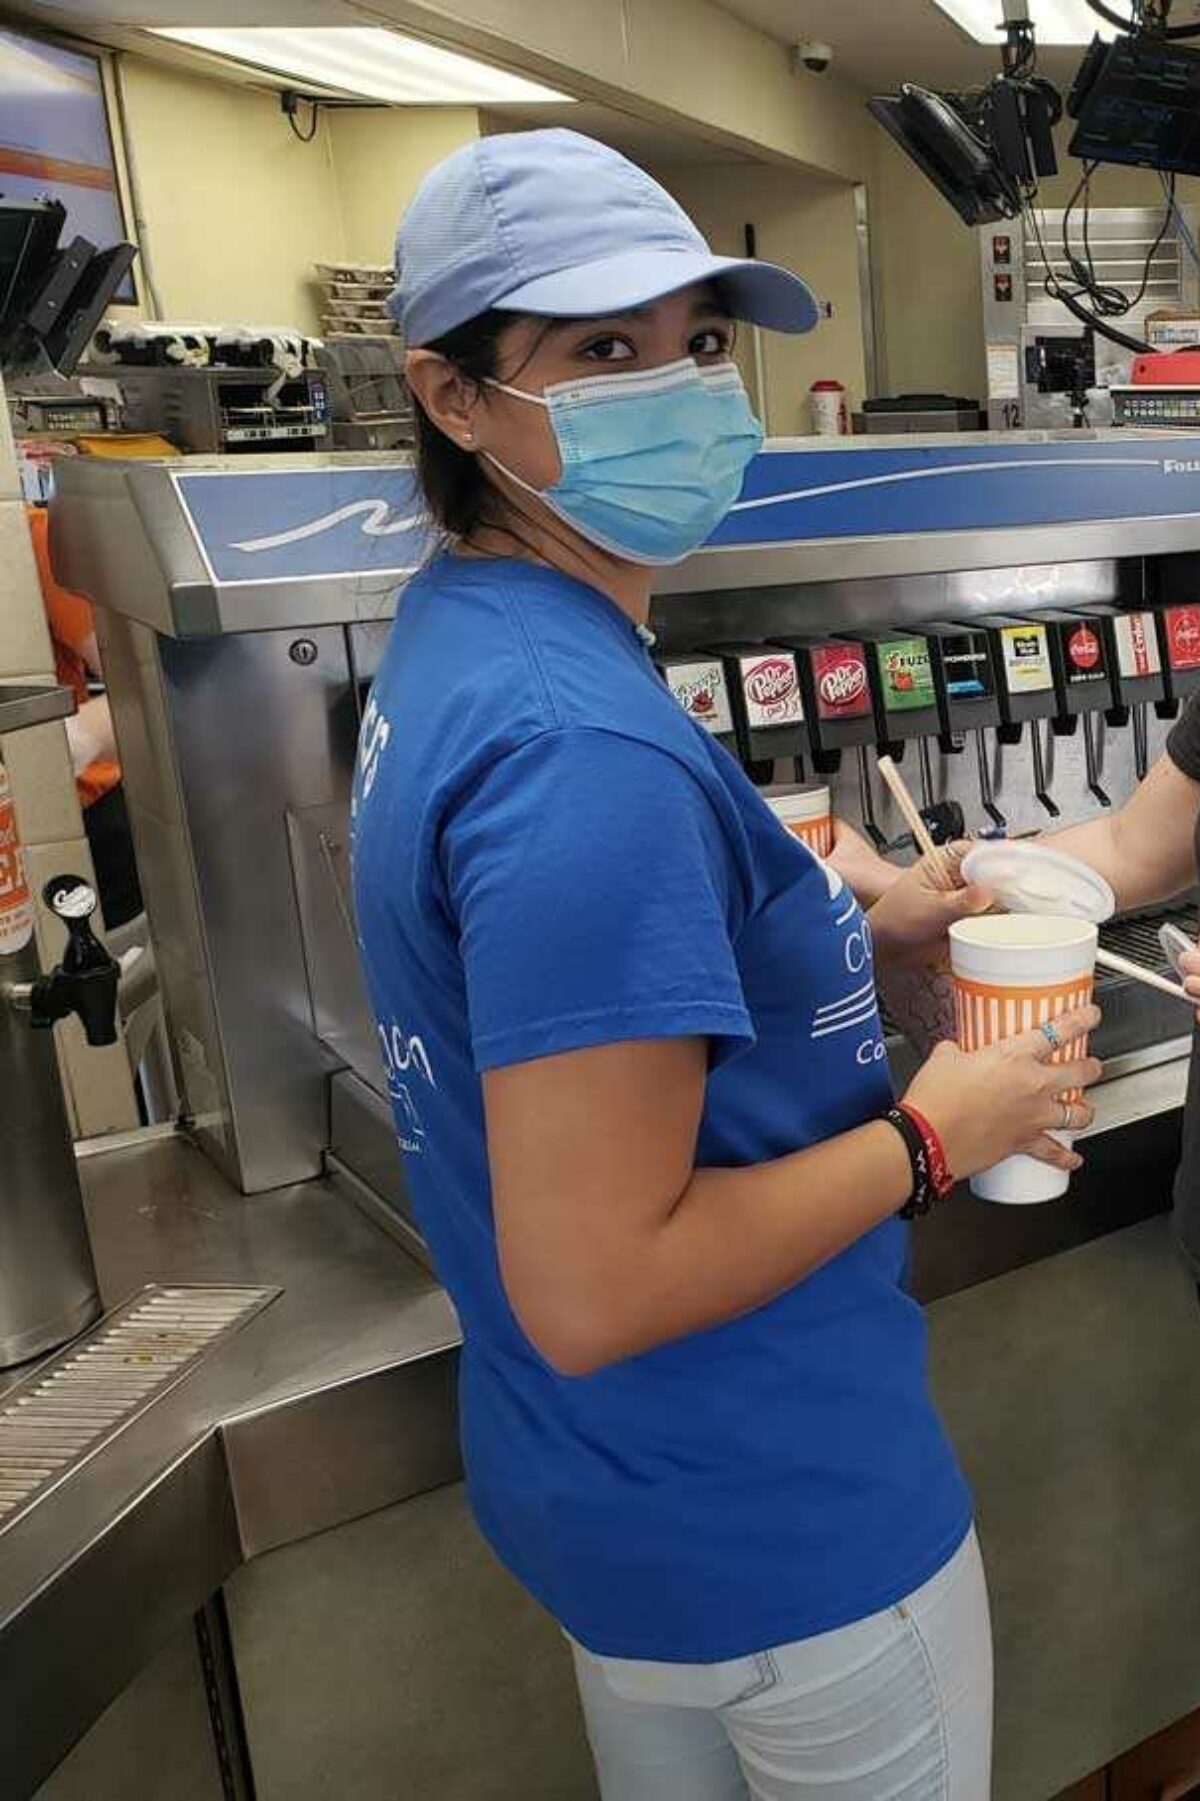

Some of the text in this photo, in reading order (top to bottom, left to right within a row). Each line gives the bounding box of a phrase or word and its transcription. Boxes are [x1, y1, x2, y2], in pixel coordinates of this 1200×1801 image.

[1002, 404, 1021, 428] 12
[750, 669, 795, 701] Pepper
[826, 669, 863, 702] Pepper
